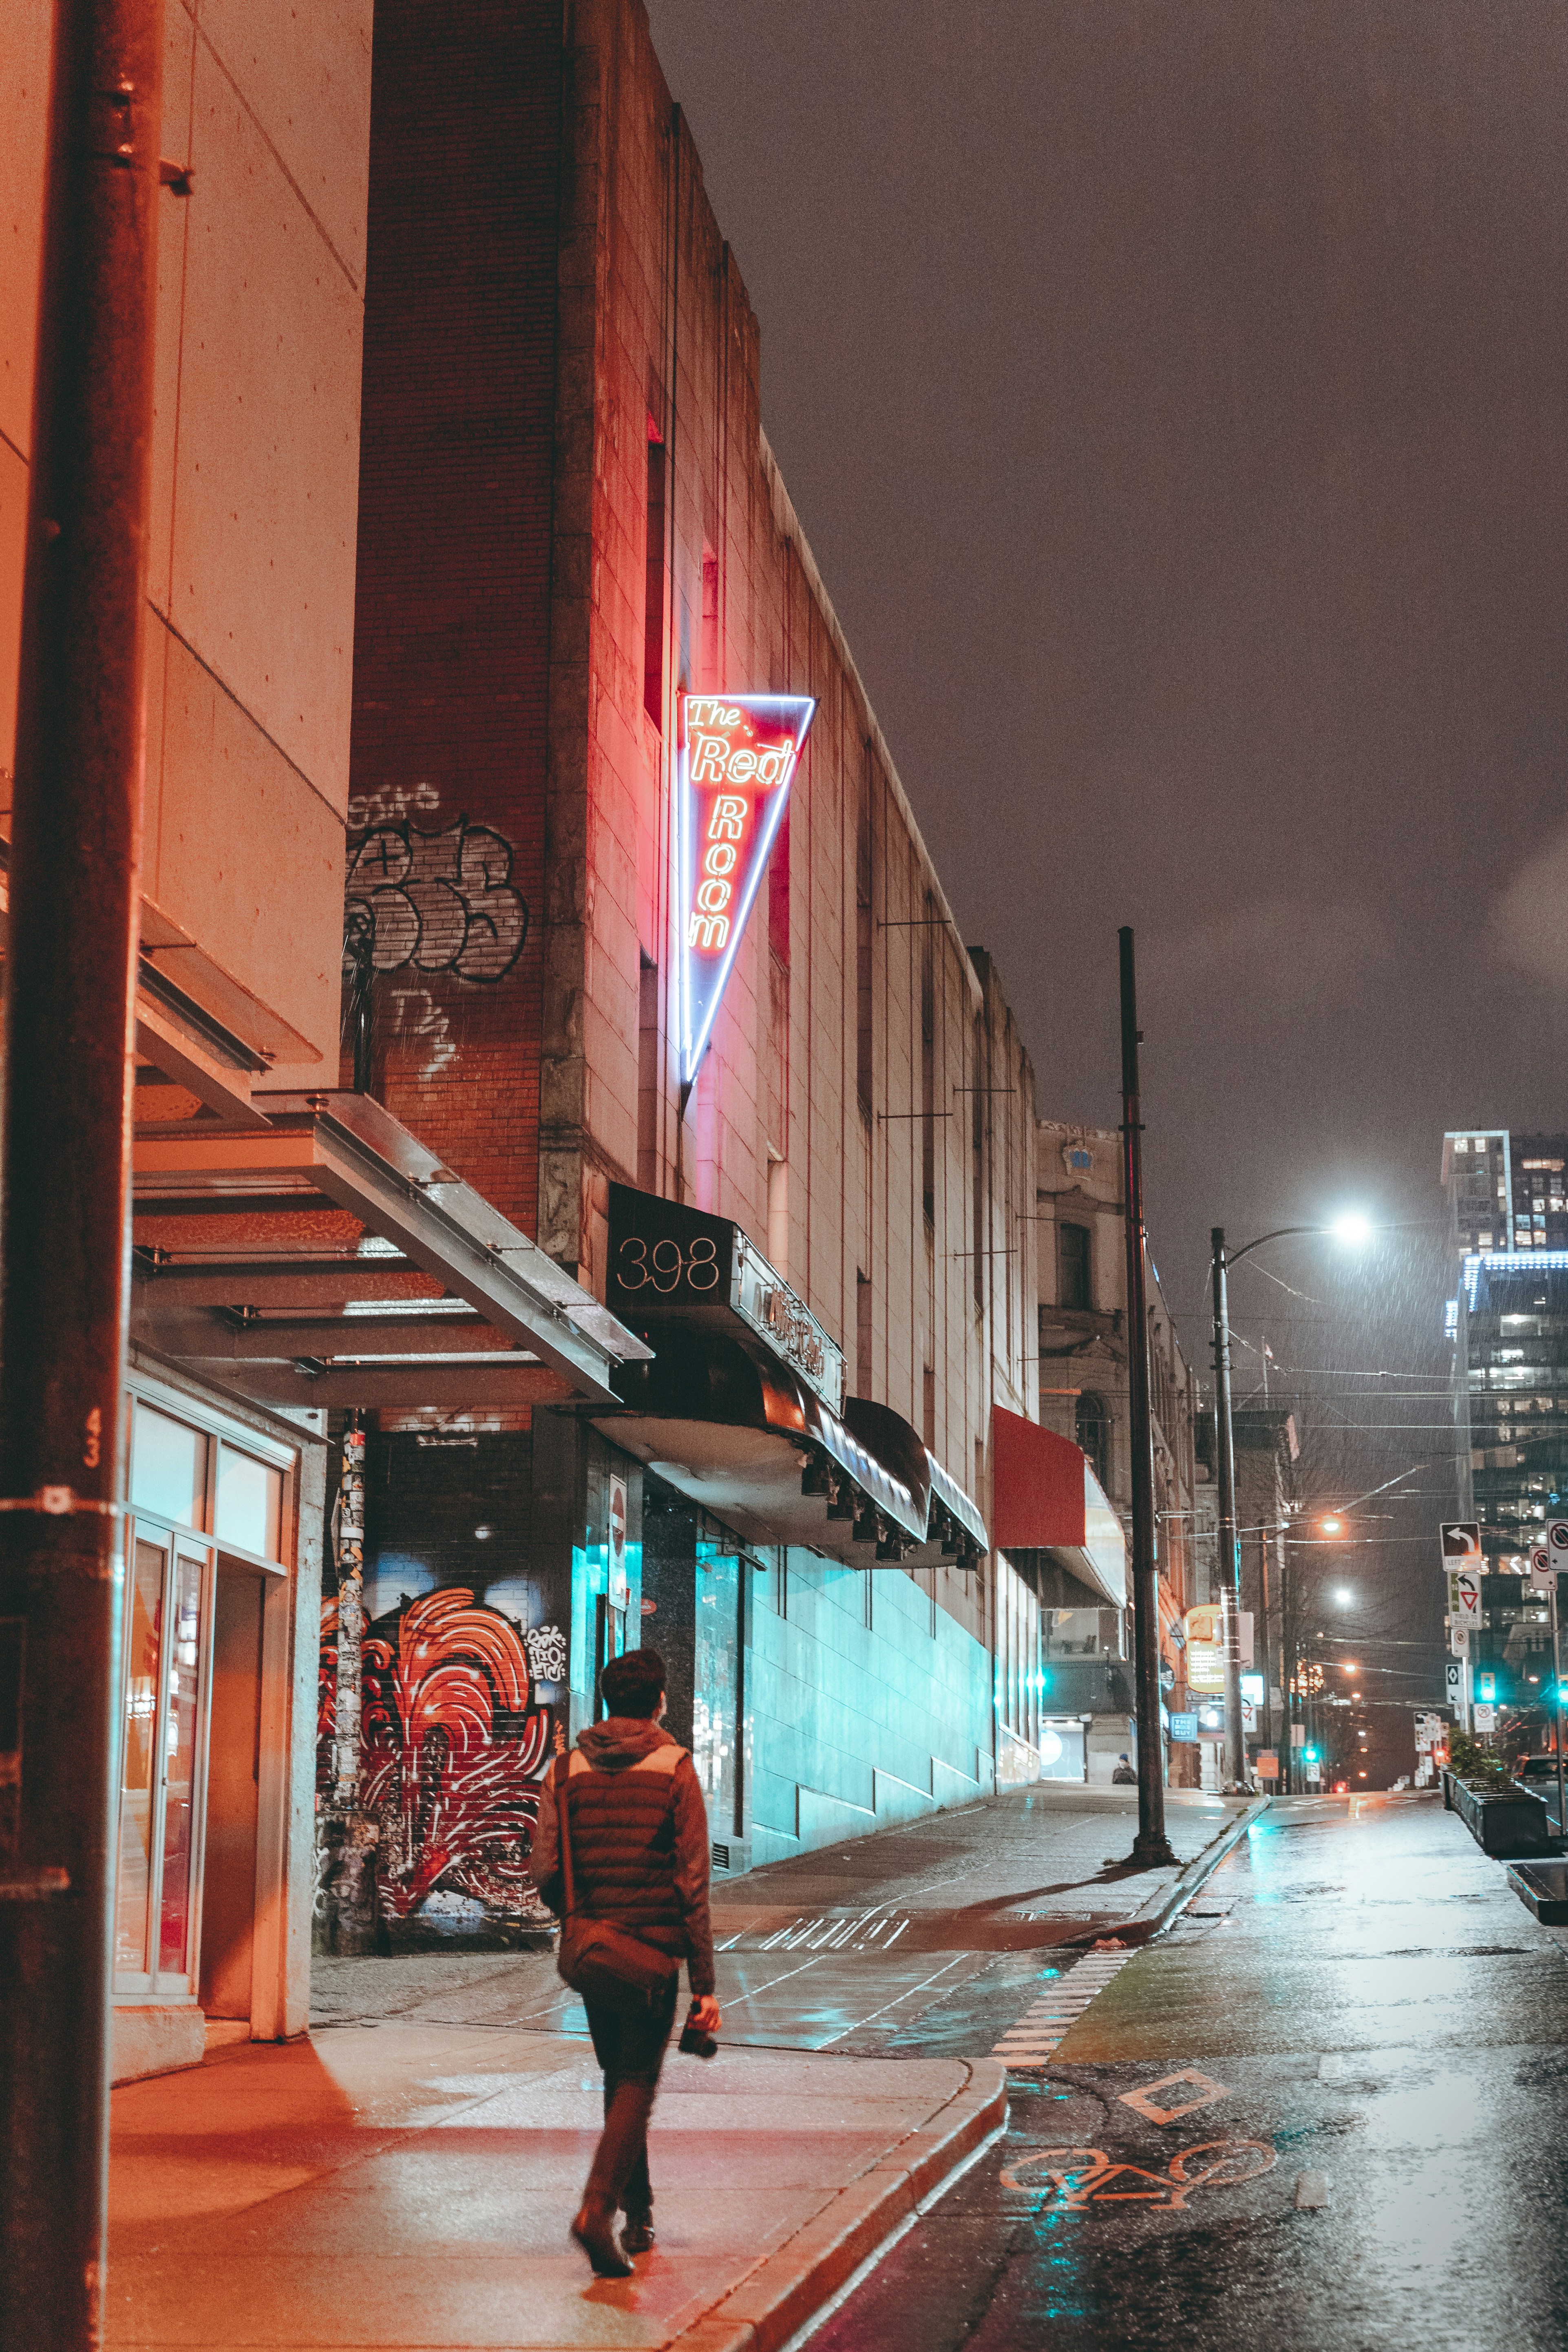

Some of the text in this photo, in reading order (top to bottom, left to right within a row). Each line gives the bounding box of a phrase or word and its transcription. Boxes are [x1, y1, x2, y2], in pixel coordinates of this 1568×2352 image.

[689, 700, 740, 727] The
[691, 735, 793, 785] Red
[617, 1237, 719, 1292] 398
